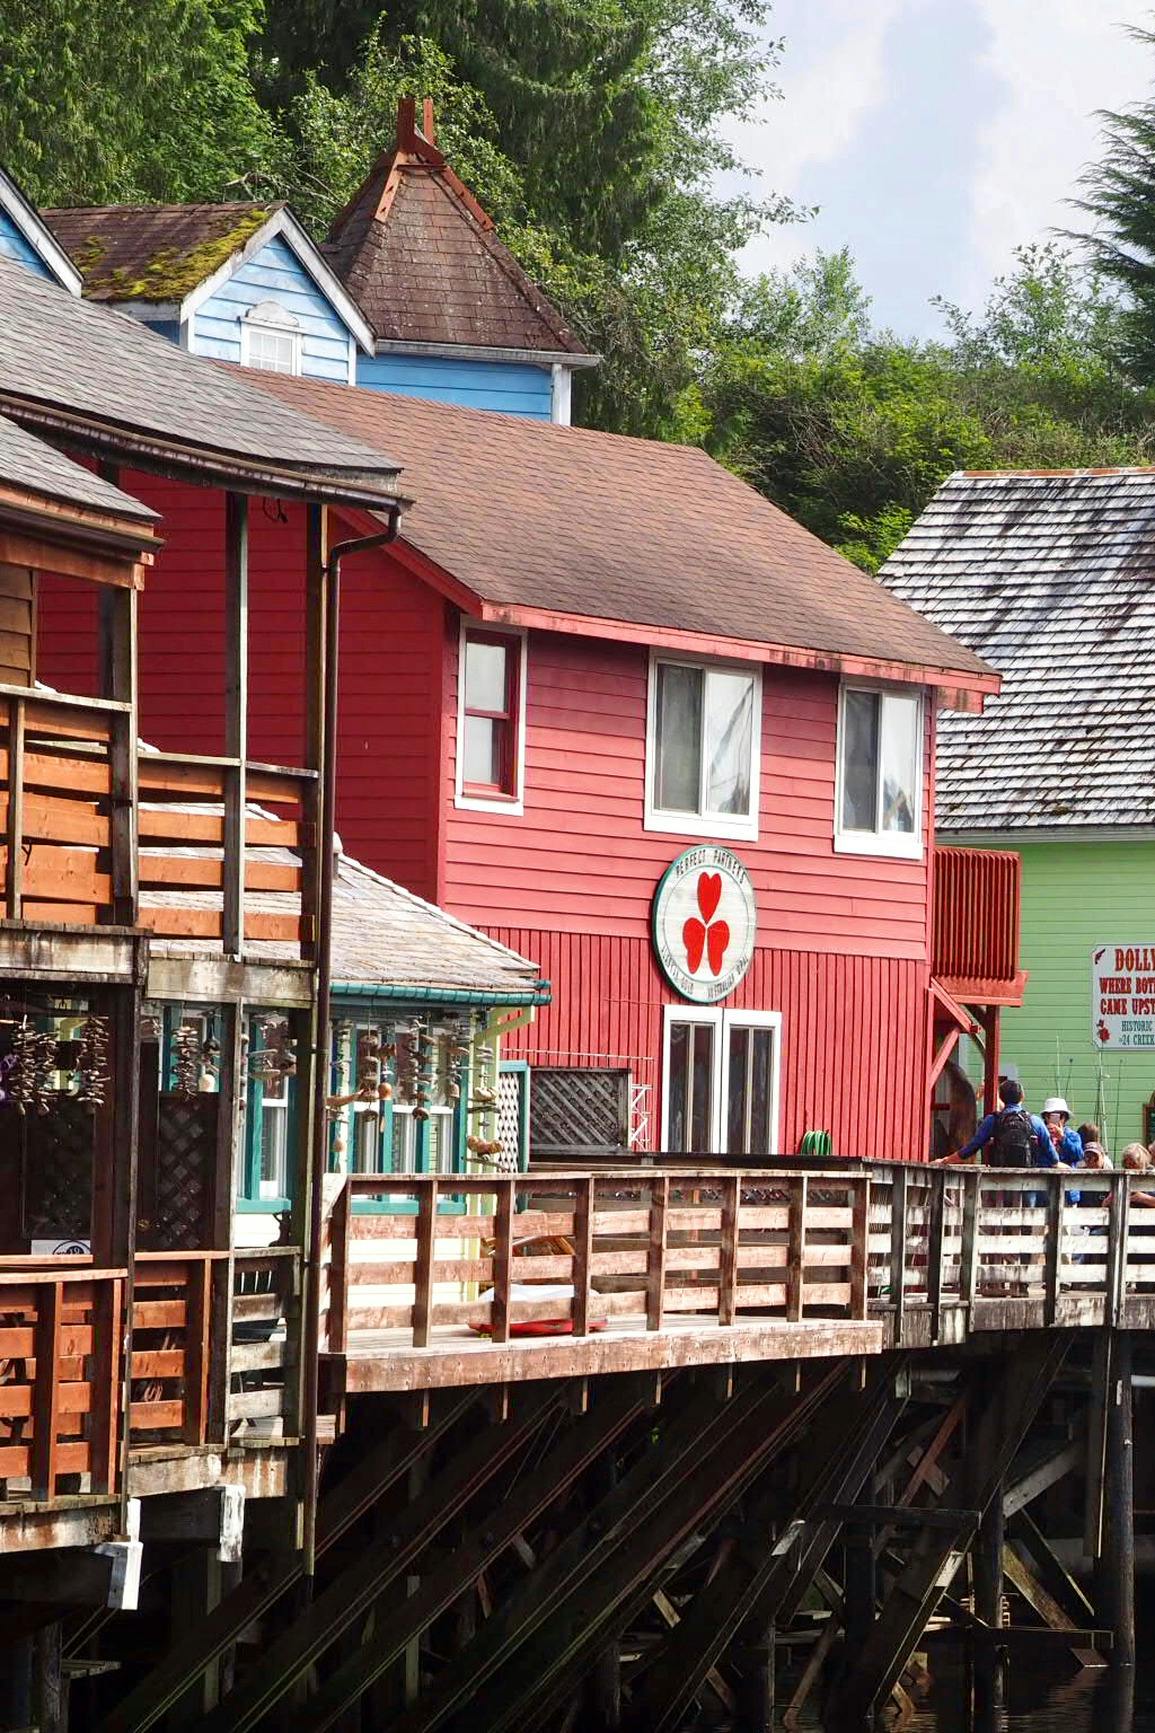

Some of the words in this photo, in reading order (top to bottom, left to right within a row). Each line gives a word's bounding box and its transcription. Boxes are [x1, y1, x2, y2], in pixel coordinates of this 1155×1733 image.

[676, 849, 706, 879] PERFECT
[713, 849, 746, 885] PARTNERS
[1099, 977, 1132, 995] WHERE
[1100, 998, 1127, 1016] CAME
[1121, 1020, 1153, 1031] HISTORIC
[1132, 1034, 1155, 1046] CREEK
